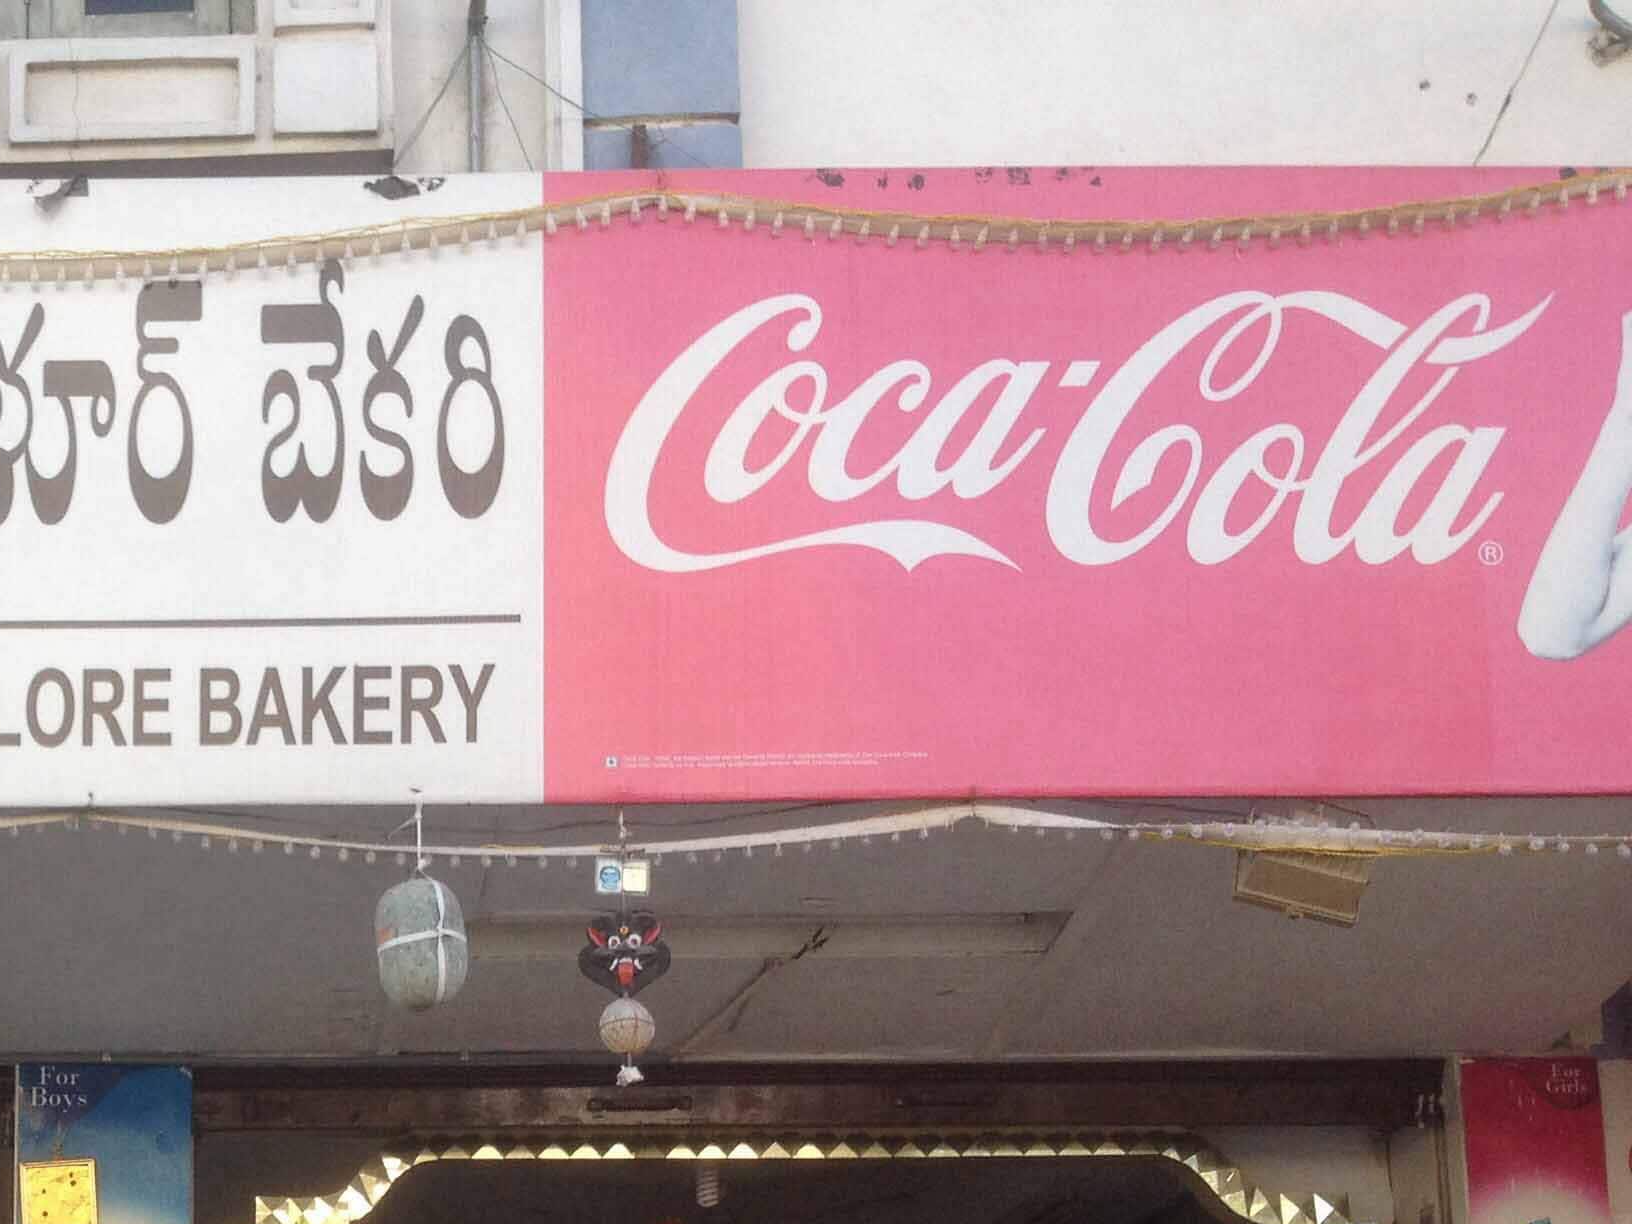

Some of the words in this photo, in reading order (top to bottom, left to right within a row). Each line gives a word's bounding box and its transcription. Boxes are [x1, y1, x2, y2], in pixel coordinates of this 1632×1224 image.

[604, 290, 1555, 573] Coca-Cola
[200, 663, 495, 745] BAKERY
[31, 1088, 88, 1113] Boys
[40, 1066, 80, 1087] For
